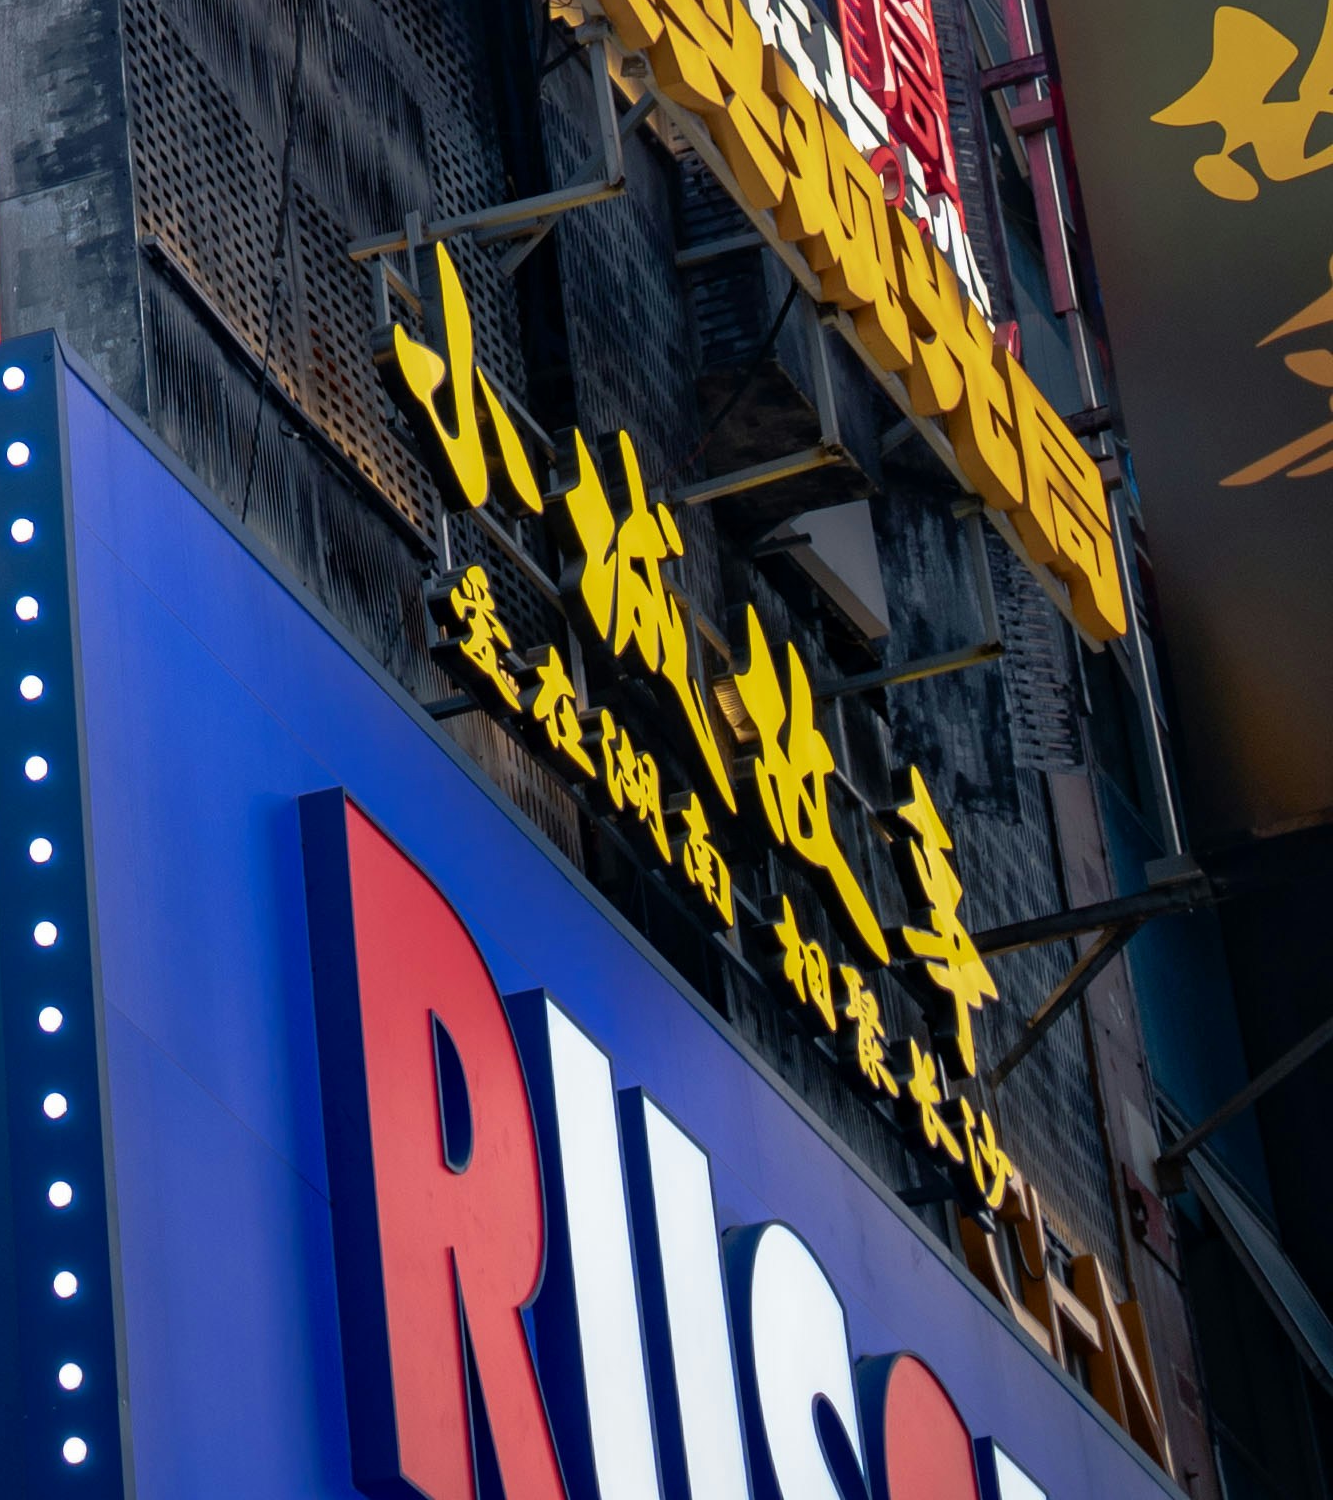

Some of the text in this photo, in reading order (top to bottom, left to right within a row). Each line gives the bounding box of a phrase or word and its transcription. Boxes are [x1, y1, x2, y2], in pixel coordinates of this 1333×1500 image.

[391, 239, 999, 1077] 小城故事
[779, 894, 1015, 1210] 相聚长沙
